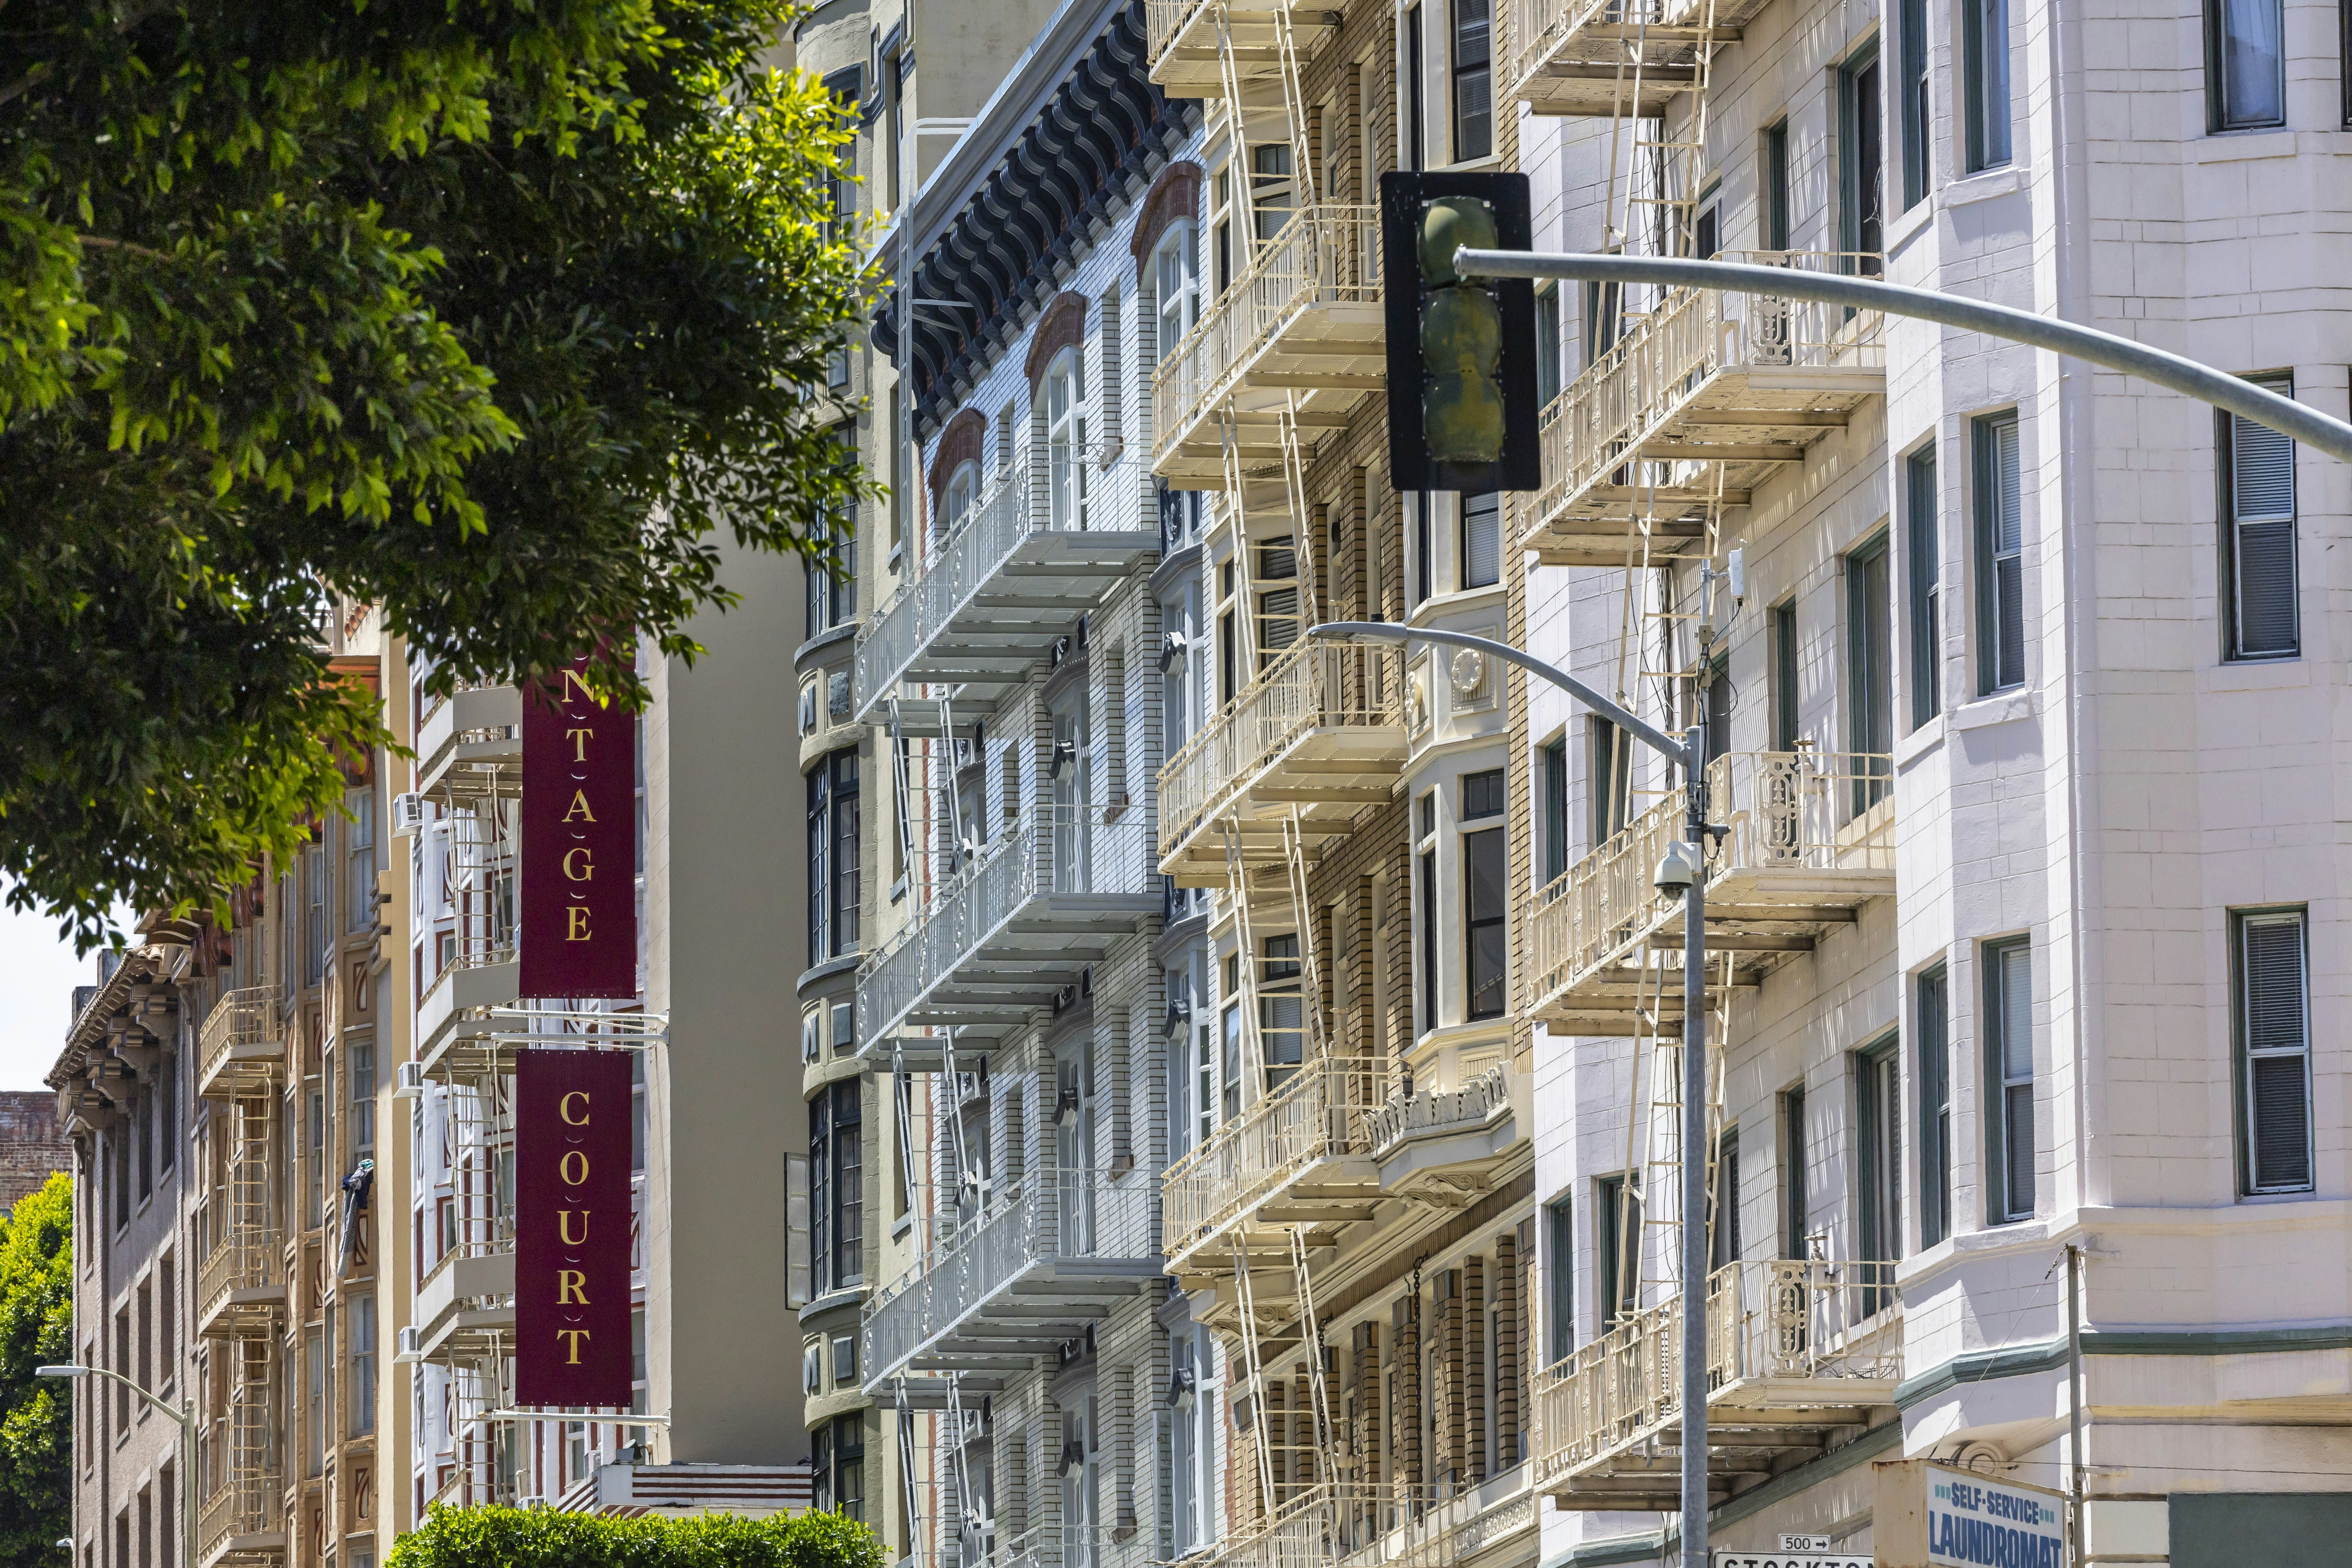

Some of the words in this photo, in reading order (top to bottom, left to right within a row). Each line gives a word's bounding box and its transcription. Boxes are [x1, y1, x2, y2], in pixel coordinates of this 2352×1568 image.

[561, 630, 597, 941] NTAGE
[556, 1091, 591, 1364] COURT
[1952, 1482, 2039, 1525] SELF-SERVICE
[1786, 1537, 1810, 1550] 500
[1929, 1510, 2062, 1568] LAUNDROMAT
